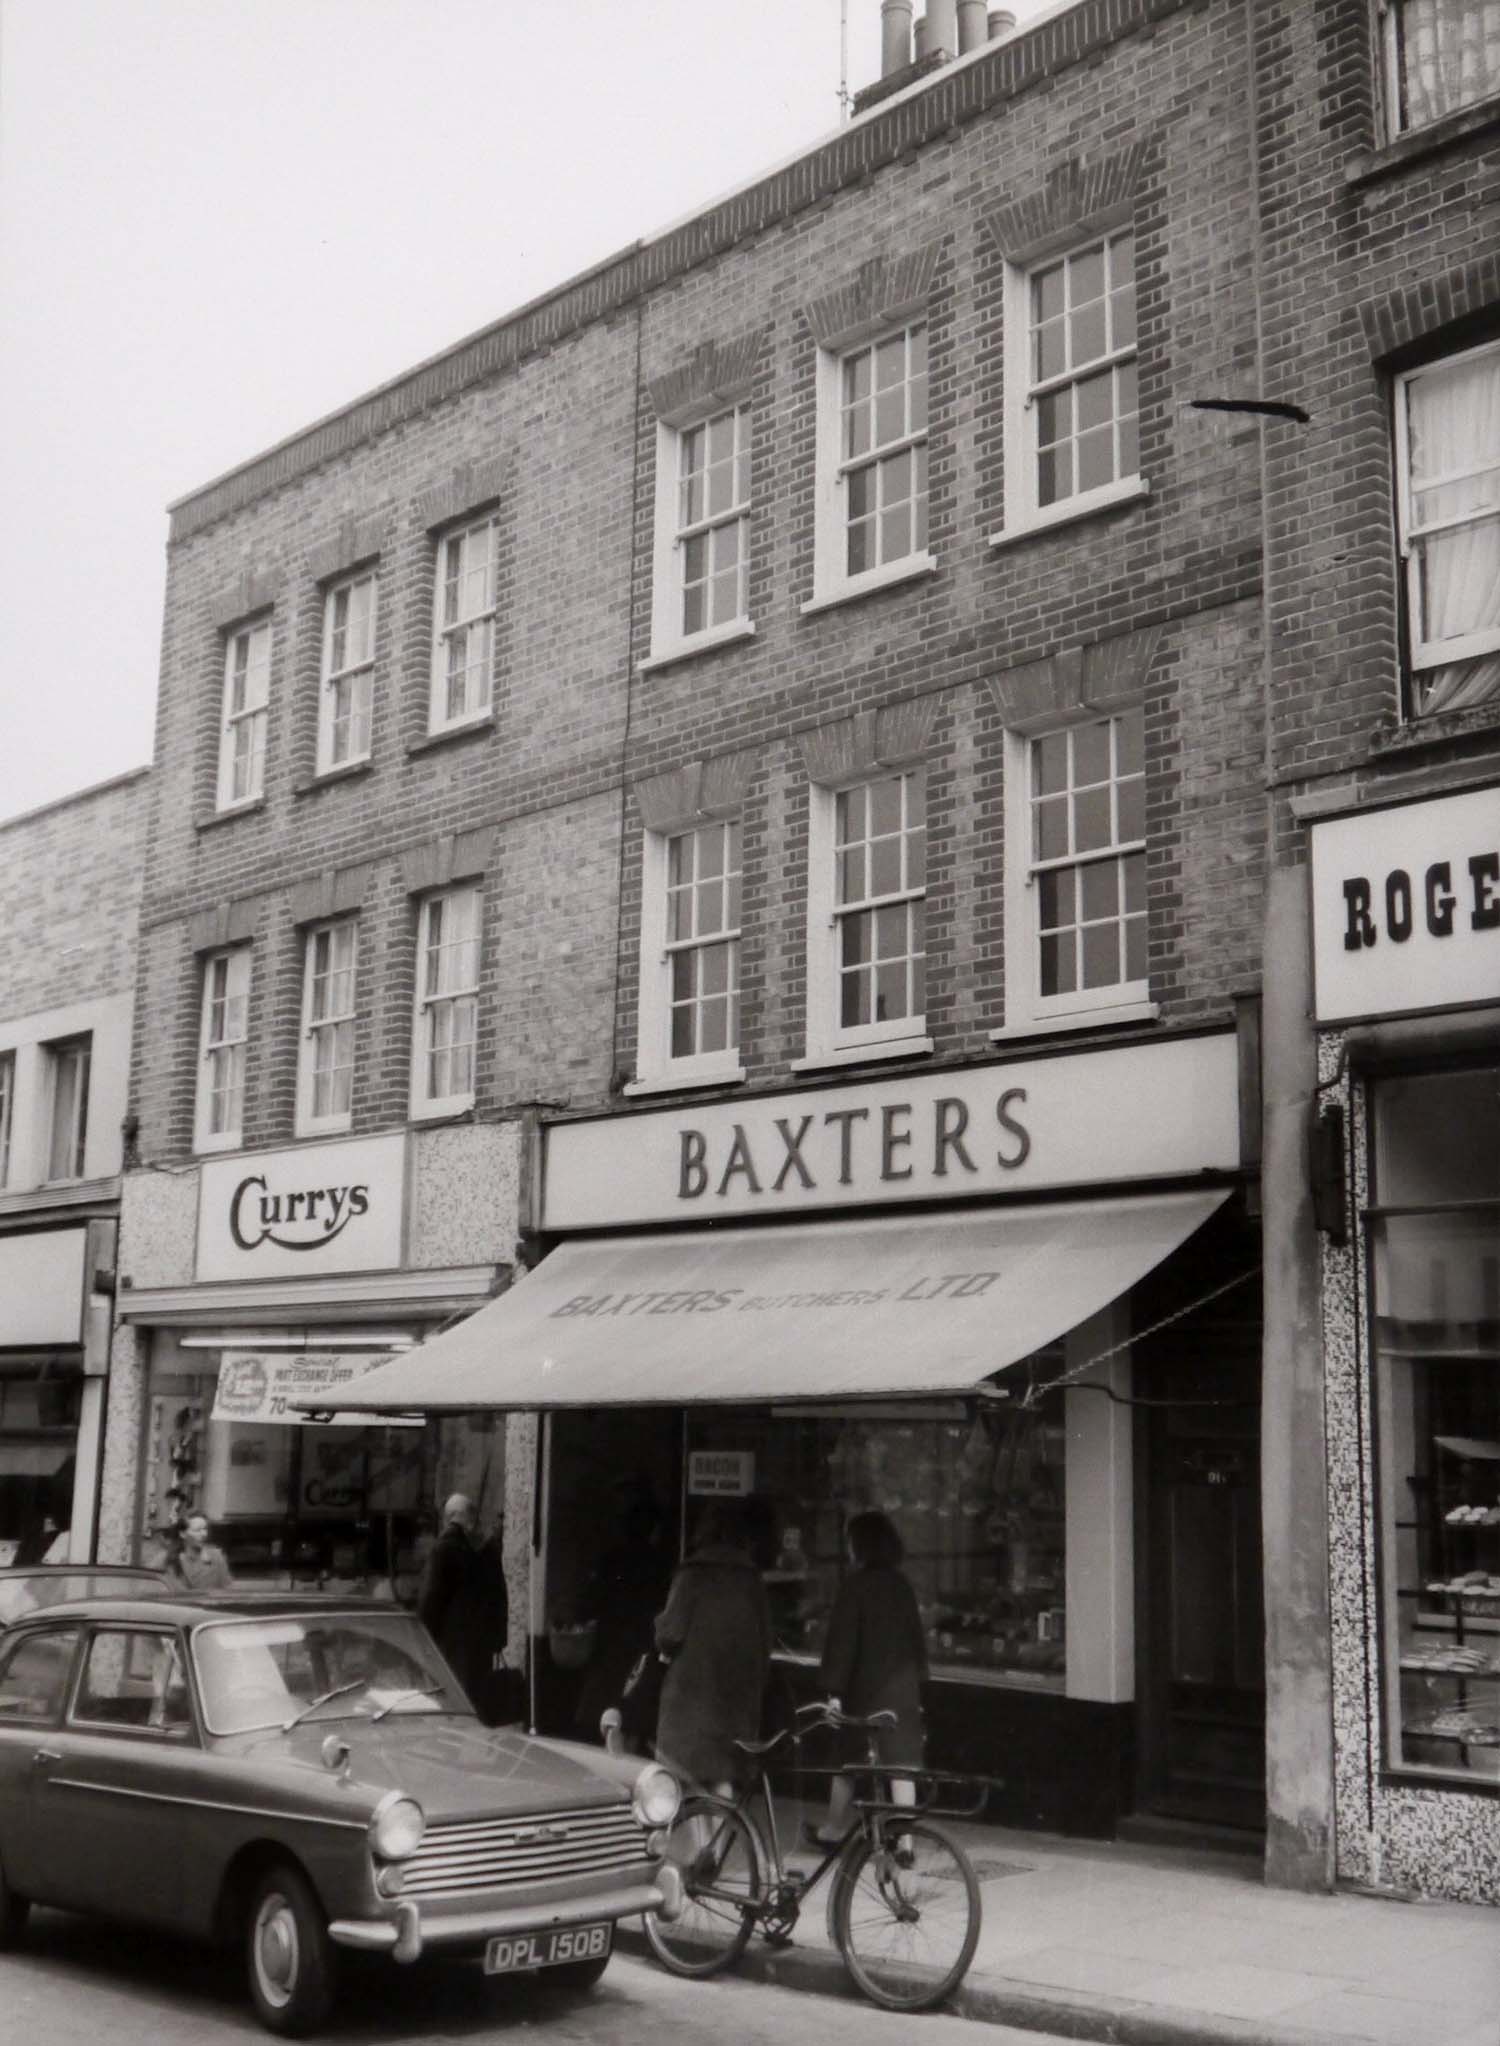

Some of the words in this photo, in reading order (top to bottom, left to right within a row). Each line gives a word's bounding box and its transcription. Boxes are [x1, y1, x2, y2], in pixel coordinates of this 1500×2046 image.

[1343, 852, 1500, 951] ROGE
[677, 1087, 1031, 1199] BAXTERS
[230, 1175, 369, 1251] Currys
[549, 1289, 744, 1318] BAXTERS
[738, 1288, 890, 1311] BUTCHERS
[495, 1938, 544, 1969] DPL
[549, 1928, 605, 1961] 150B
